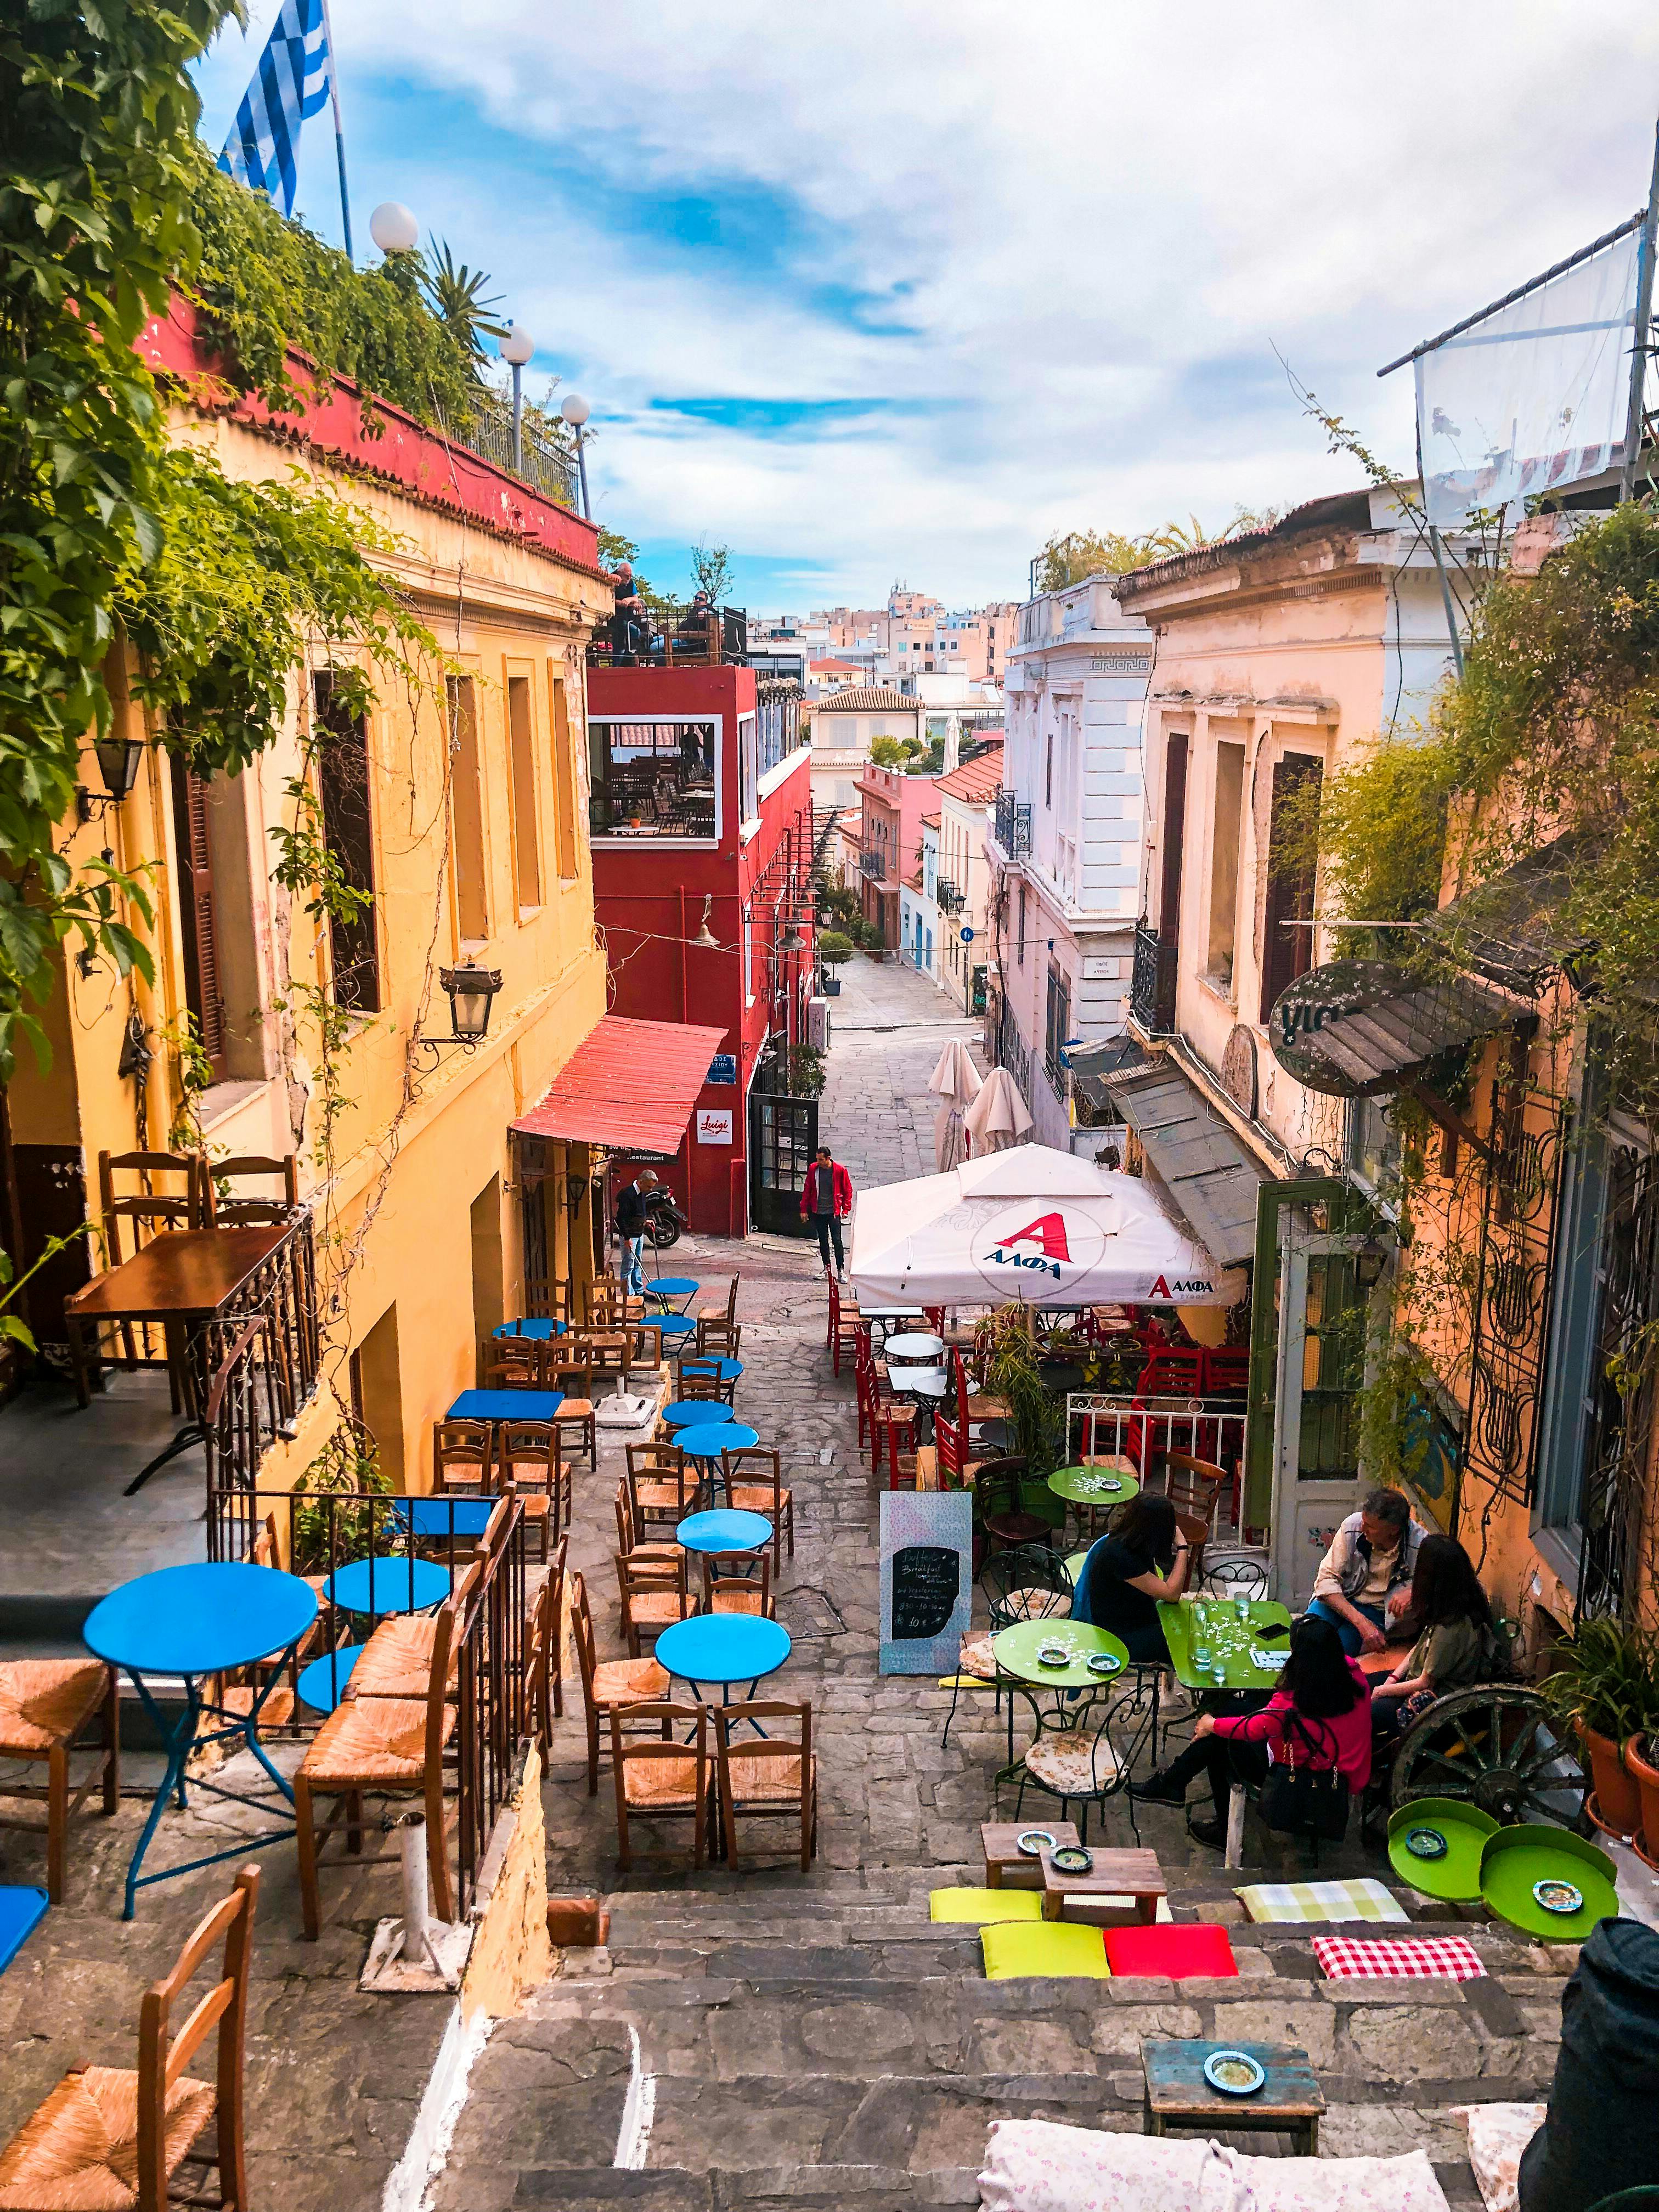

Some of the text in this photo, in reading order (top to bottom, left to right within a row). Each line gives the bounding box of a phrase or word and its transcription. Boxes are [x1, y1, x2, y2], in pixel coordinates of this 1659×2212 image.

[700, 1115, 729, 1135] Luigi
[983, 1249, 1061, 1281] ΑΛΦΑ
[1172, 1280, 1214, 1293] ΑΛΦΑ
